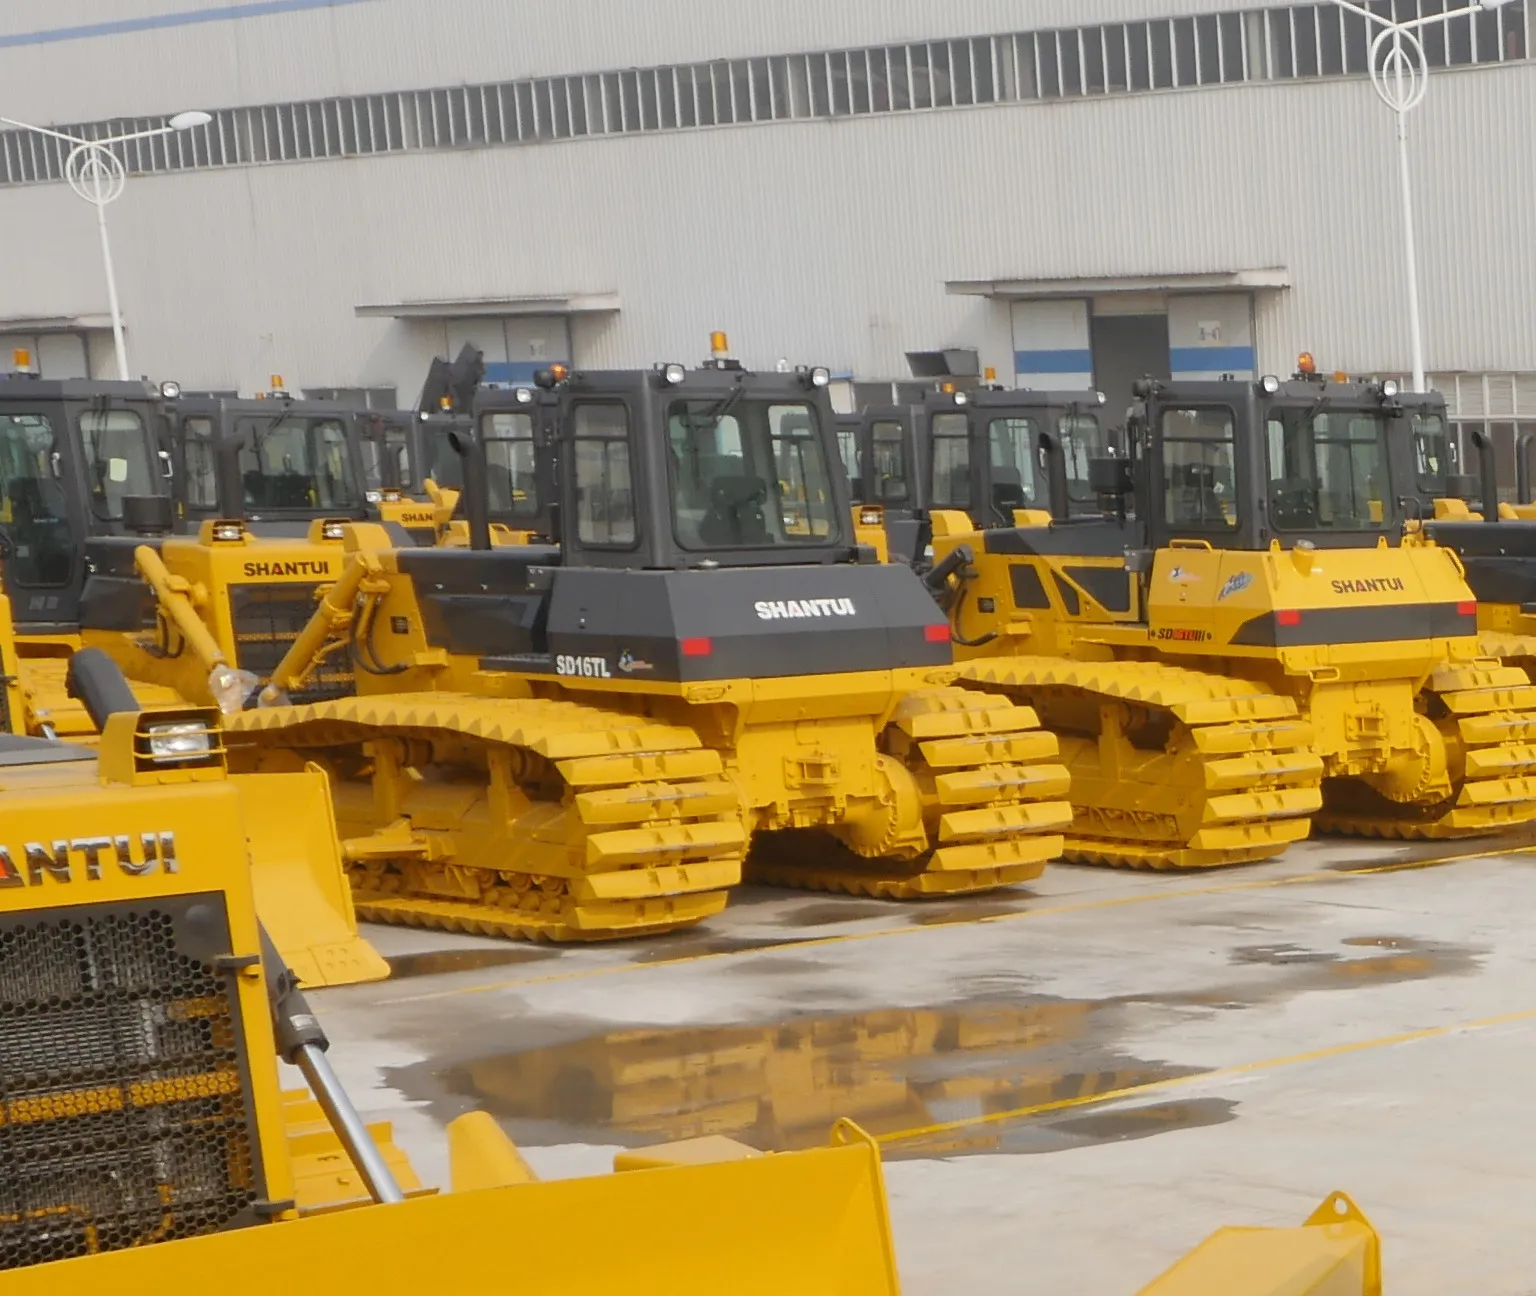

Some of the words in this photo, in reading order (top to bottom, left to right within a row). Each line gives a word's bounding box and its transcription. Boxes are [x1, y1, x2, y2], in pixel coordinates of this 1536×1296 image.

[244, 561, 329, 577] SHANTUI
[1331, 577, 1404, 594] SHANTUI
[754, 598, 856, 620] SHANTUI
[556, 654, 611, 678] SD16TL
